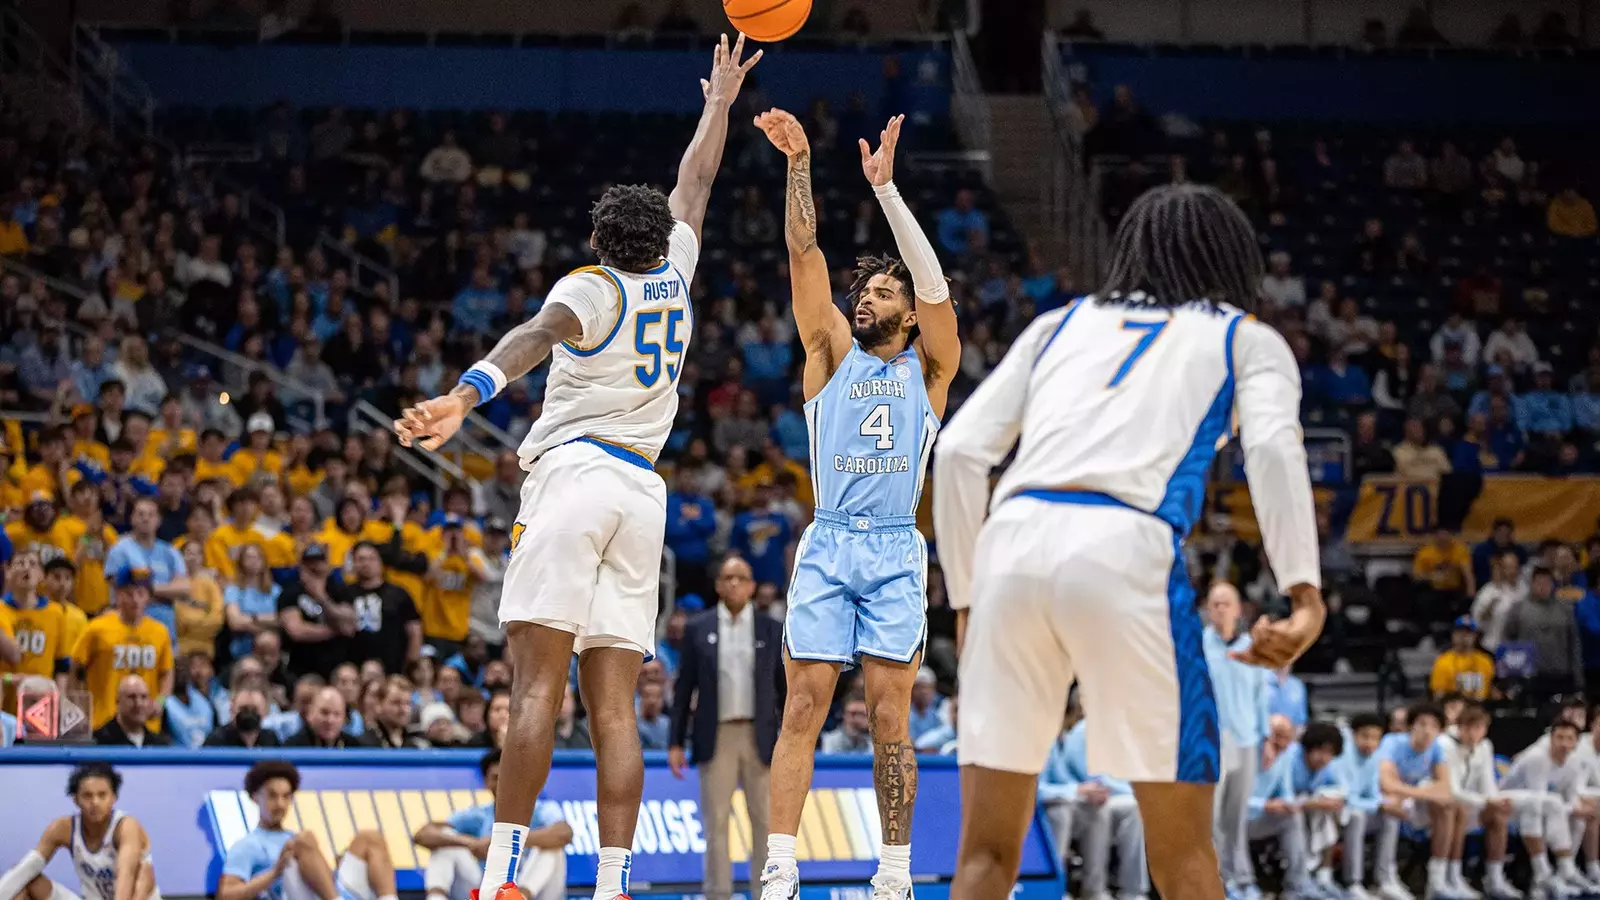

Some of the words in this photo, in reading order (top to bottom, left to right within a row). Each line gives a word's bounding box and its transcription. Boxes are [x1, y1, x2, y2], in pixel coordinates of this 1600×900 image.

[643, 280, 680, 301] AUSTIN
[633, 307, 684, 390] 55
[1105, 318, 1172, 390] 7
[850, 379, 906, 400] NORTH
[860, 404, 894, 450] 4
[833, 453, 910, 474] CAROLINA
[1375, 484, 1430, 536] ZO
[630, 799, 707, 854] OISE
